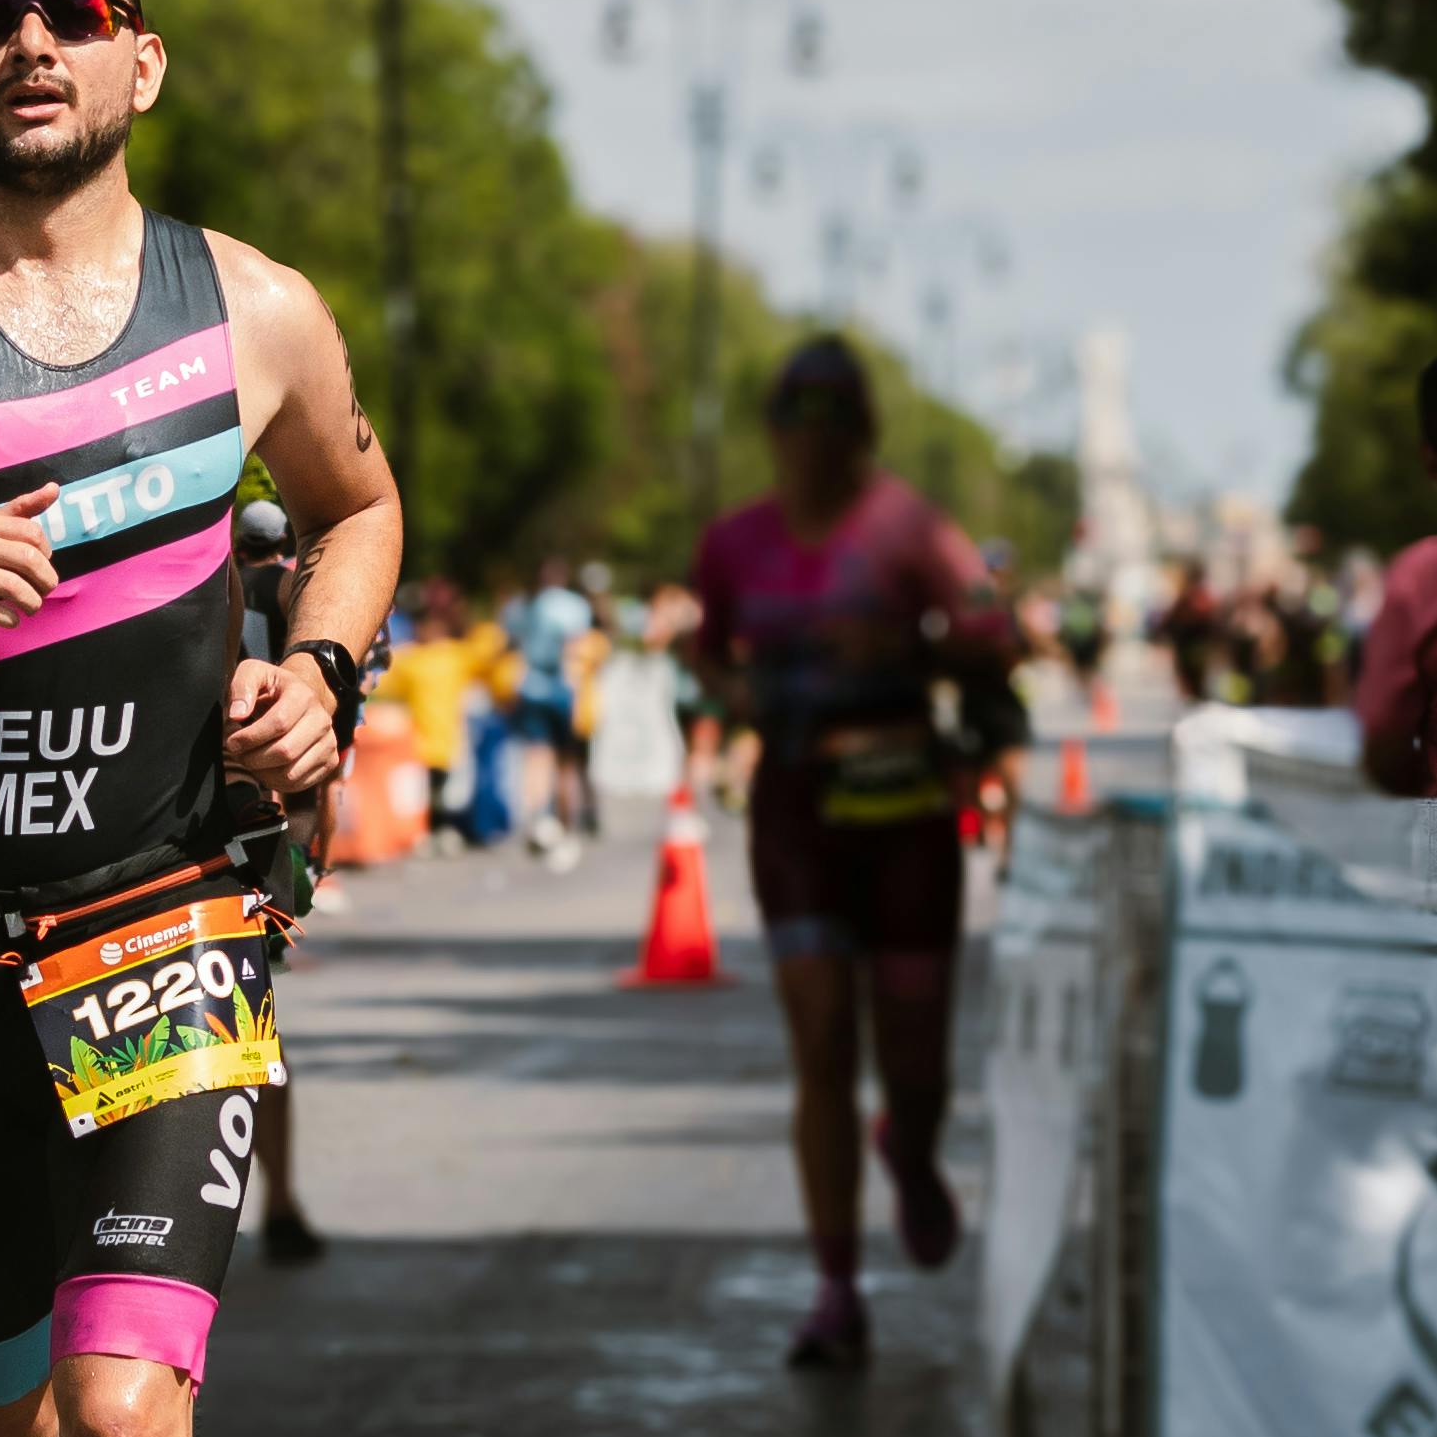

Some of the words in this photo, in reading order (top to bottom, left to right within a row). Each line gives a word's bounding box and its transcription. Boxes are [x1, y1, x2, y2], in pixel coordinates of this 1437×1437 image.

[110, 356, 206, 406] TEAM
[30, 463, 175, 542] ITTO
[124, 918, 200, 953] Cinemex
[72, 949, 235, 1041] 1220
[115, 1081, 145, 1098] astri
[200, 1087, 259, 1209] VO
[96, 1216, 168, 1232] racing
[96, 1233, 166, 1247] apparel
